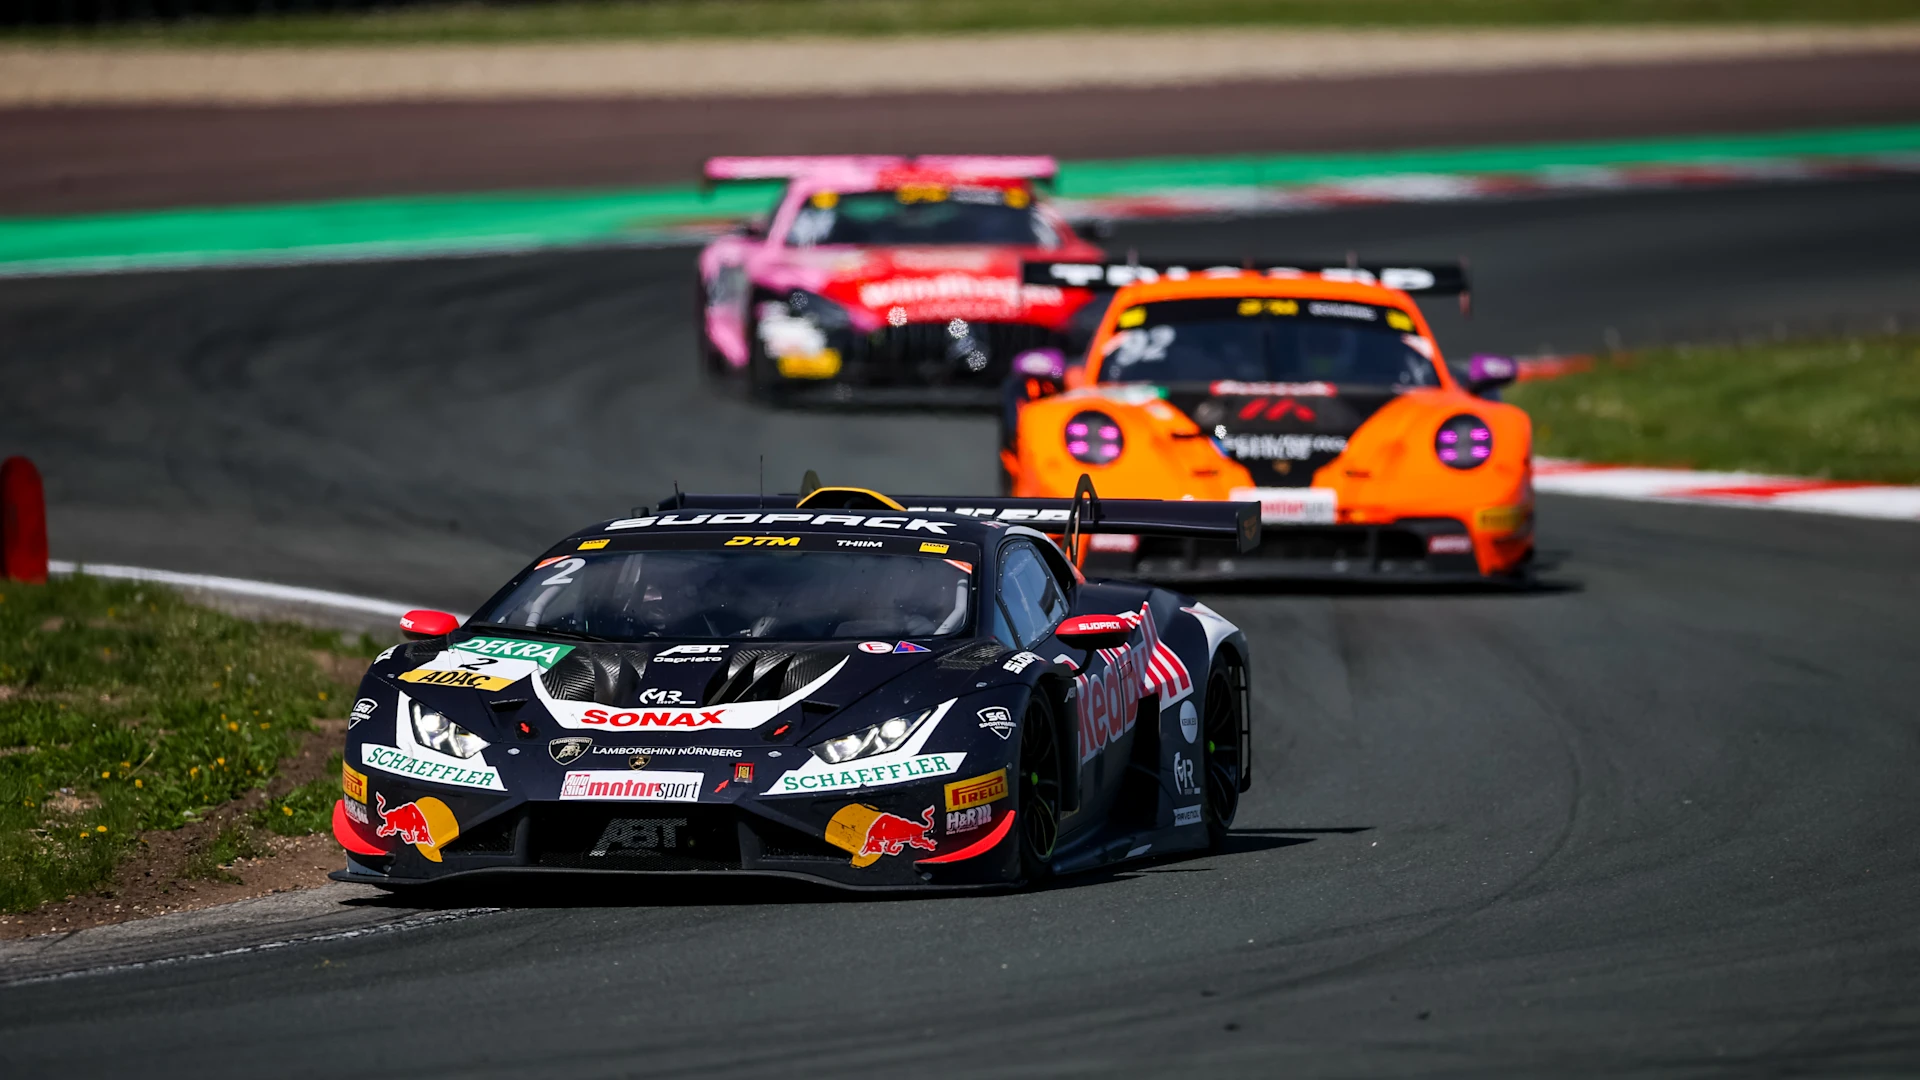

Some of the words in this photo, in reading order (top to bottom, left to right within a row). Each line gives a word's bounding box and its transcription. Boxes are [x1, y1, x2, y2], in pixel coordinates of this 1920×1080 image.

[723, 536, 801, 546] DTM
[836, 539, 883, 548] THIIM
[541, 558, 586, 586] 2
[455, 638, 562, 664] DEKRA
[656, 644, 730, 657] ABT
[457, 658, 499, 671] 2
[416, 671, 491, 687] ADAC
[581, 709, 728, 727] SONAX
[985, 711, 1008, 721] SG
[592, 746, 676, 755] LAMBORGHINI
[677, 745, 743, 757] NÜRNBERG
[366, 747, 496, 786] SCHAEFFLER
[783, 755, 951, 790] SCHAEFFLER
[588, 780, 699, 799] motorsport
[951, 775, 1004, 806] PIRELLI
[946, 809, 977, 831] H&R
[589, 818, 688, 857] ABT
